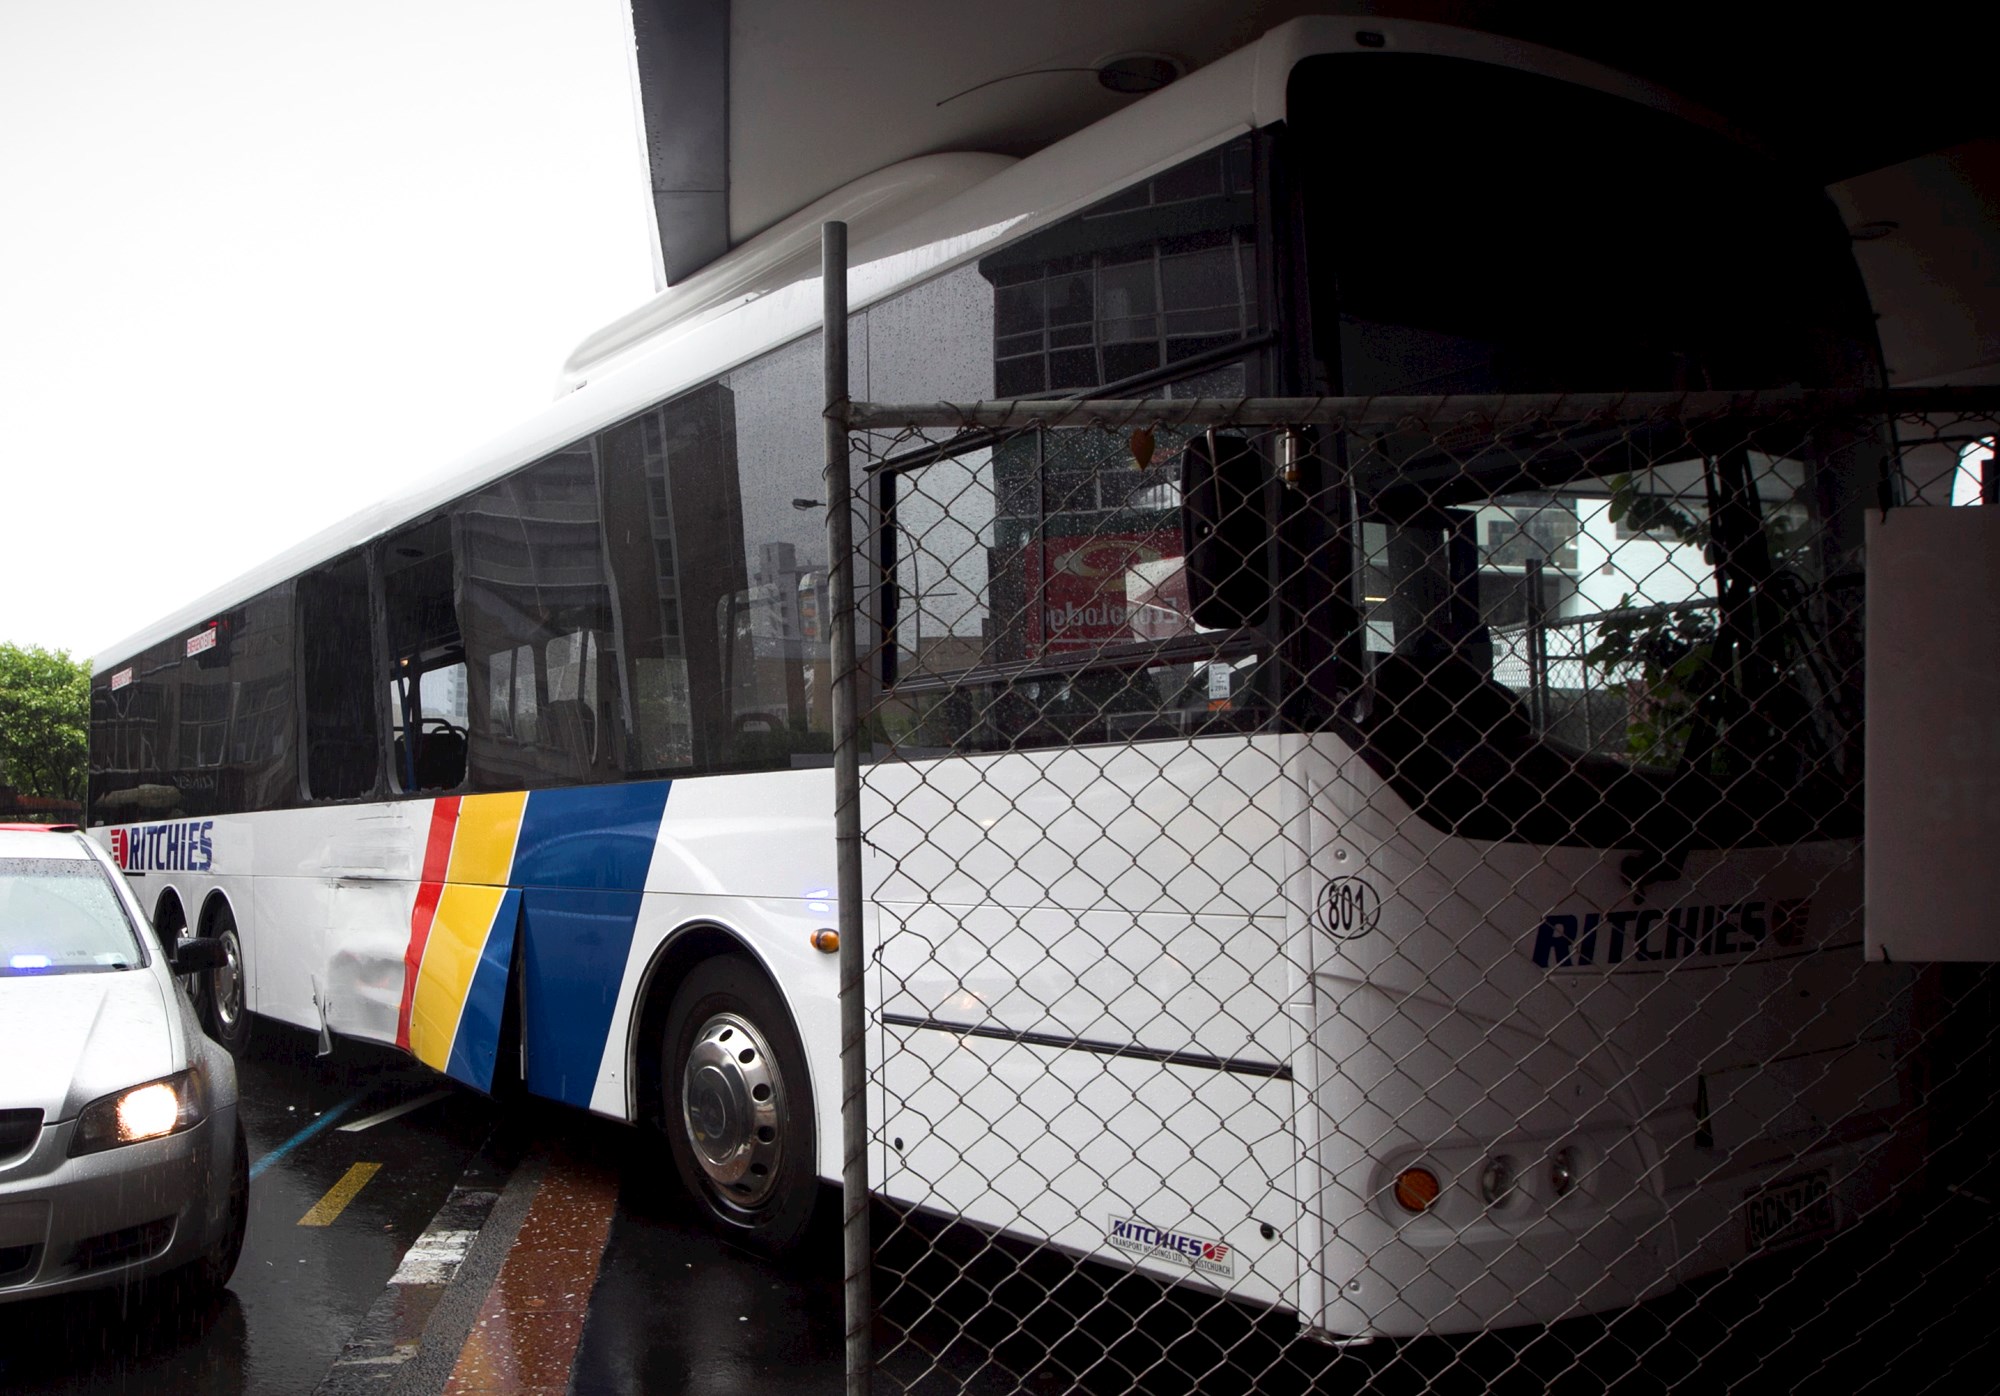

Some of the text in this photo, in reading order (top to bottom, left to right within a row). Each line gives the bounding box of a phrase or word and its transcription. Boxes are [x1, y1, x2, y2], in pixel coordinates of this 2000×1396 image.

[129, 821, 213, 871] RITCHIES
[1329, 885, 1364, 930] 801
[1532, 902, 1766, 968] RITCHIES
[1112, 1236, 1142, 1251] TRANSPORT
[1113, 1220, 1202, 1257] RITCHIES
